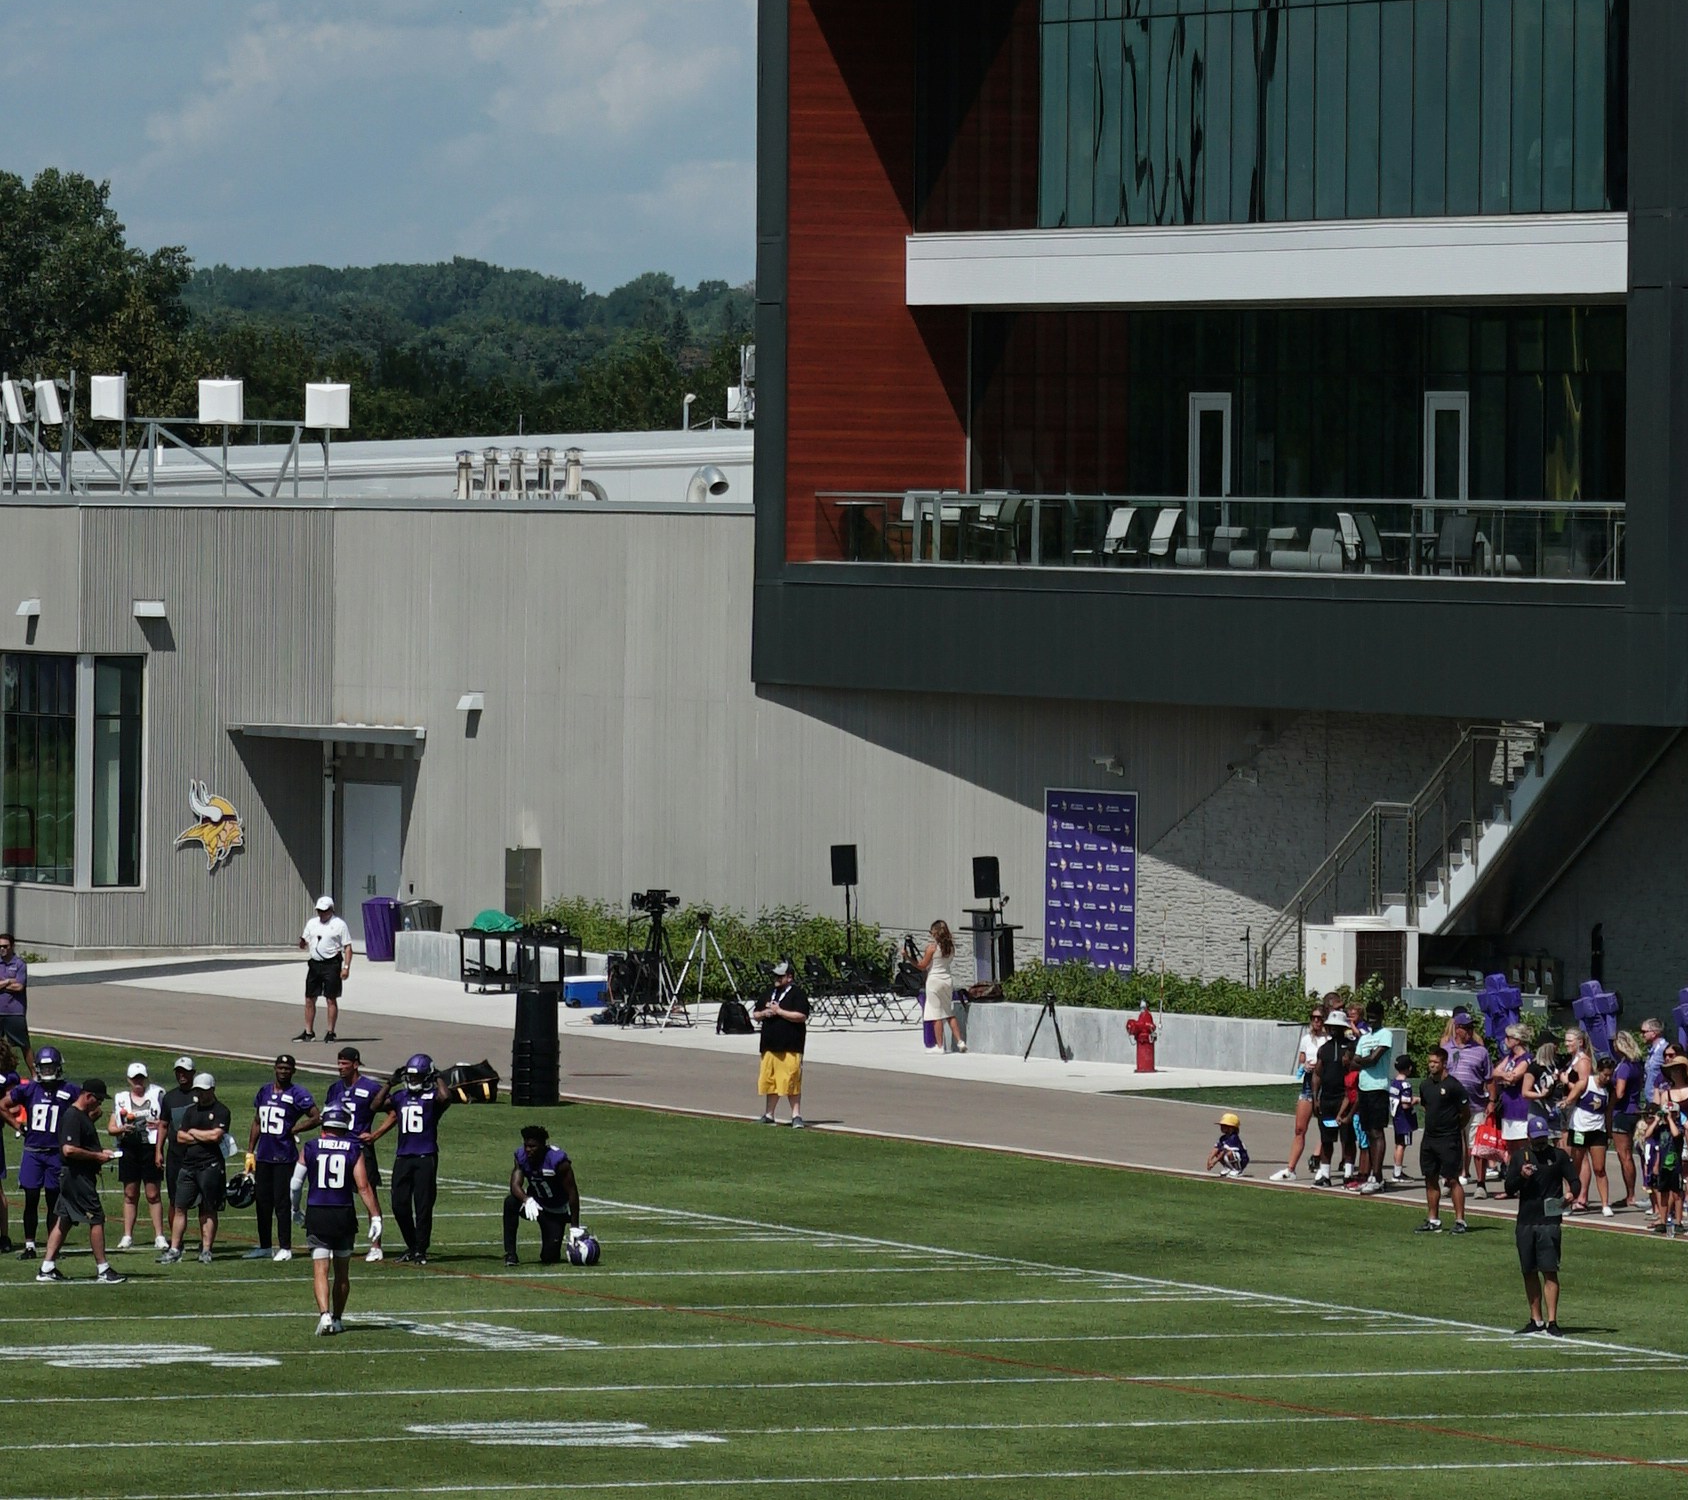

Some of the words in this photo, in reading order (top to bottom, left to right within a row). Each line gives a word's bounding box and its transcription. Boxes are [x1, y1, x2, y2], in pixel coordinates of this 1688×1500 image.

[31, 1104, 59, 1133] 81
[259, 1106, 286, 1135] 85
[401, 1106, 424, 1134] 16
[316, 1153, 346, 1189] 19
